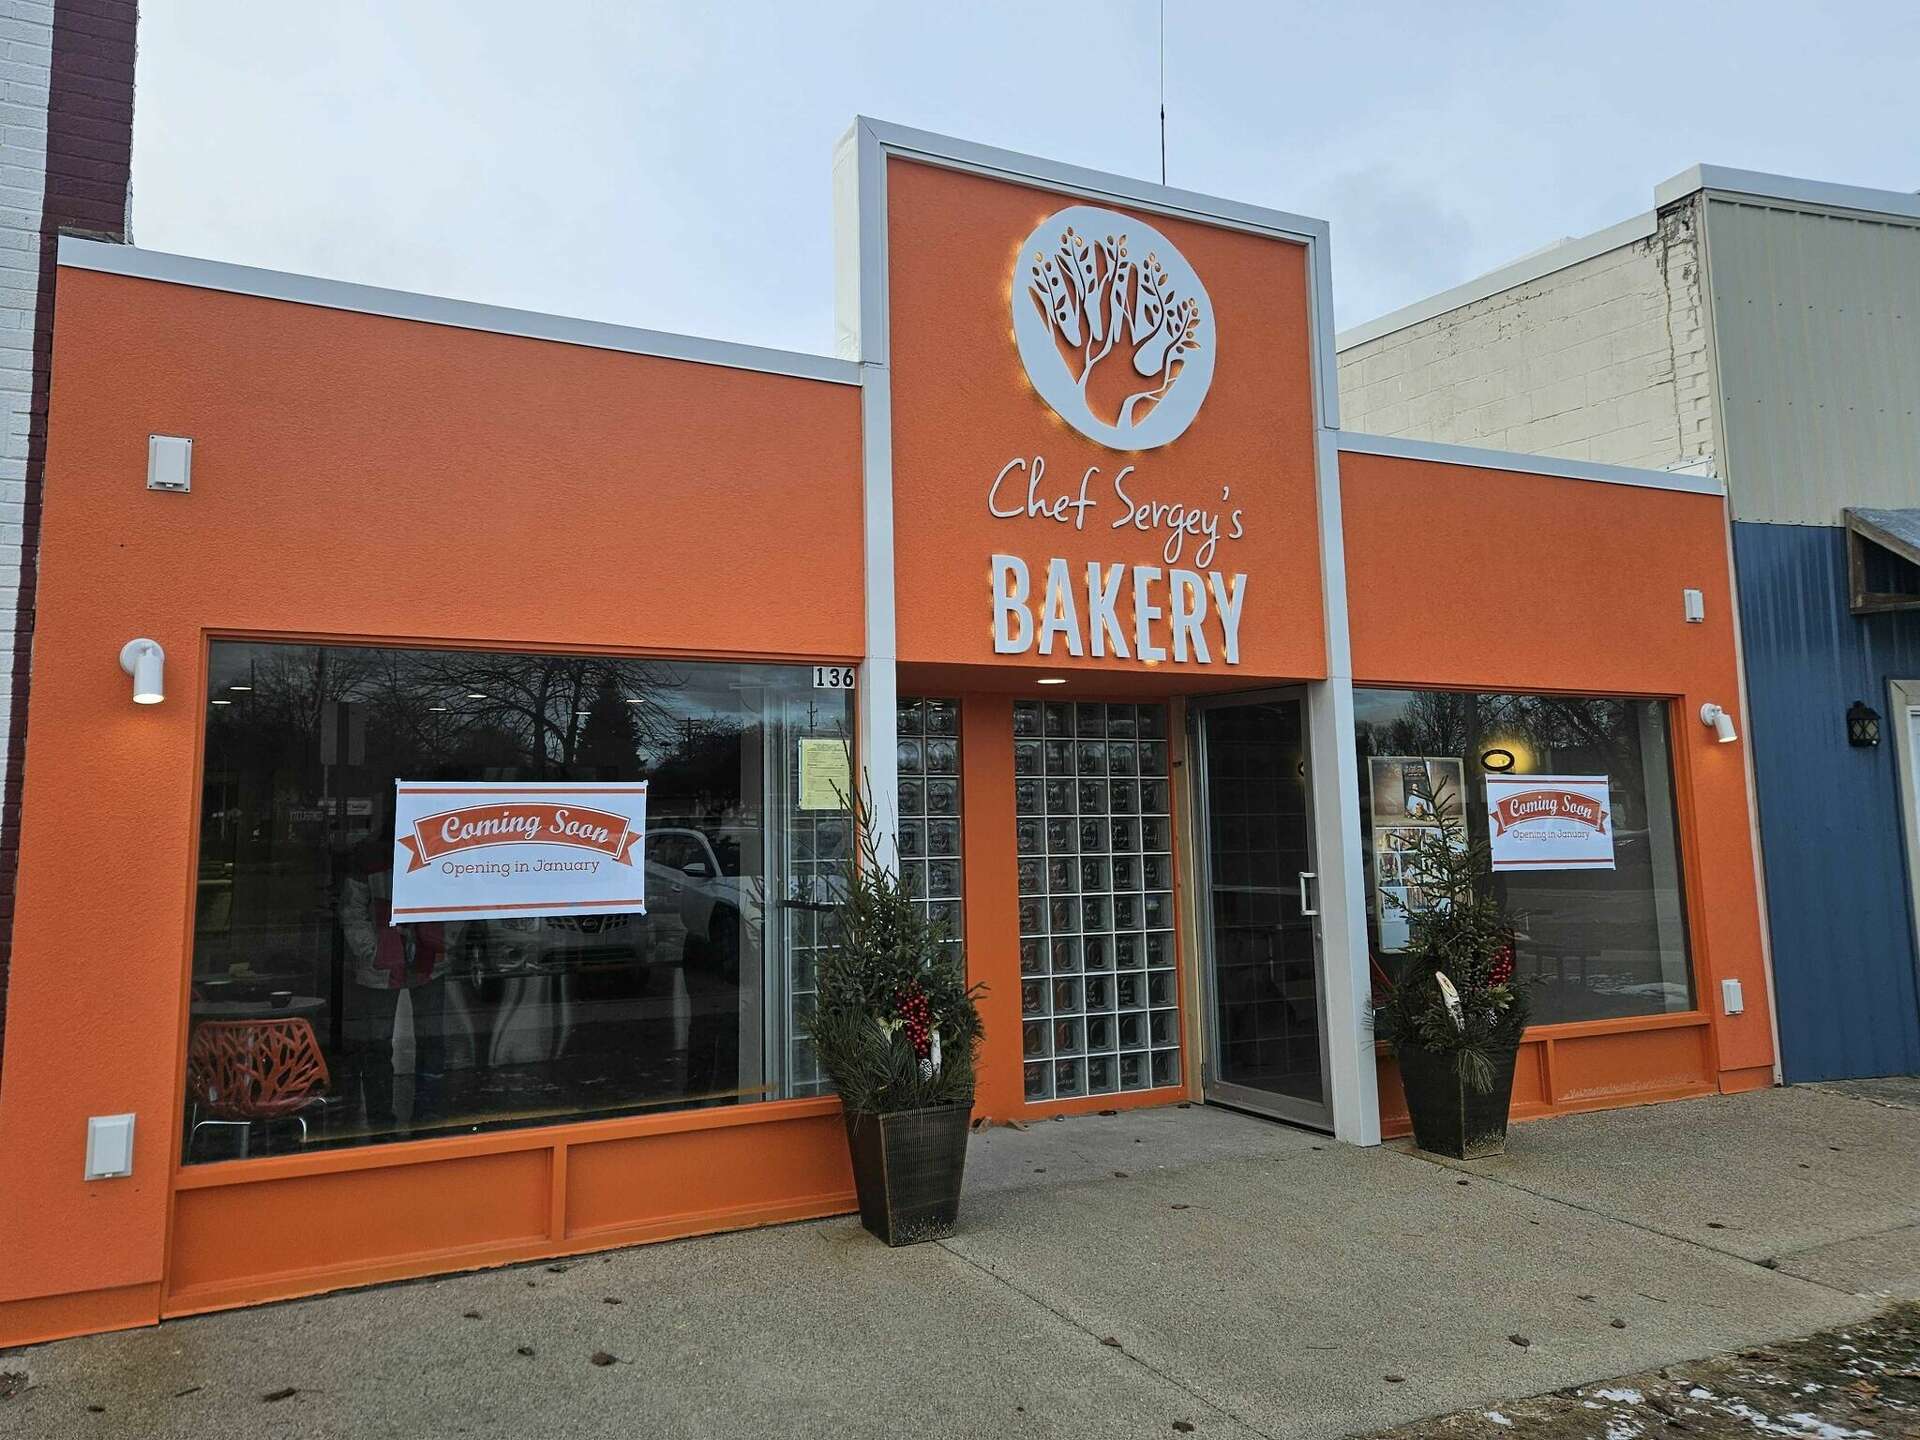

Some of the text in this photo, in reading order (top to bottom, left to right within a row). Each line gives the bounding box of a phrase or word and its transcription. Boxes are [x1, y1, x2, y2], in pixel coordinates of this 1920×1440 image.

[987, 455, 1244, 569] Chef Sergey's
[991, 554, 1248, 664] BAKERY
[816, 667, 854, 687] 136
[1510, 794, 1593, 819] Coming Soon
[441, 809, 609, 843] Coming Soon
[1512, 829, 1547, 841] Opening
[1557, 829, 1590, 840] January
[441, 858, 600, 877] Opening in January
